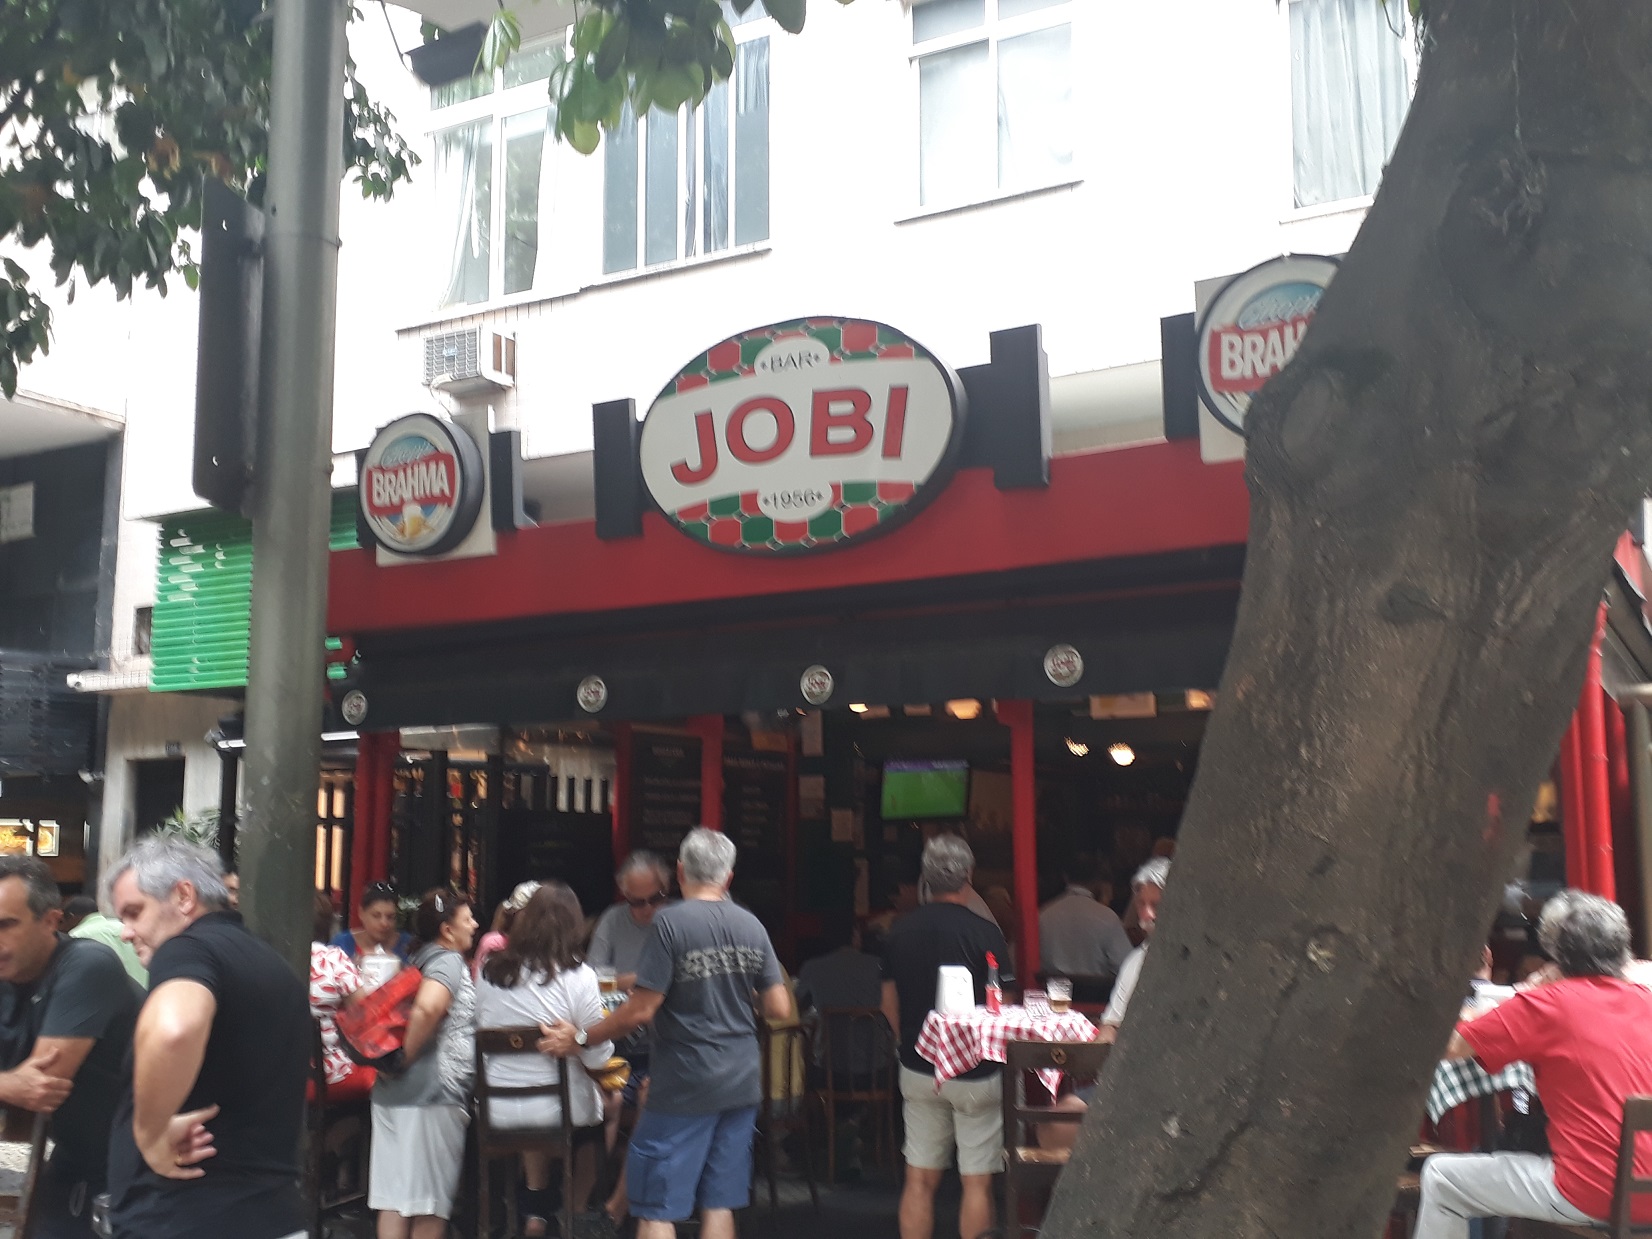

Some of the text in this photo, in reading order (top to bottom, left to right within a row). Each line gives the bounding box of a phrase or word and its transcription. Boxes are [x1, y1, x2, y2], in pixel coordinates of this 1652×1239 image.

[770, 350, 813, 373] BAR
[1220, 318, 1308, 380] BRAH
[670, 383, 909, 487] JOBI
[372, 459, 451, 508] BRAHMA
[770, 489, 816, 510] 1956
